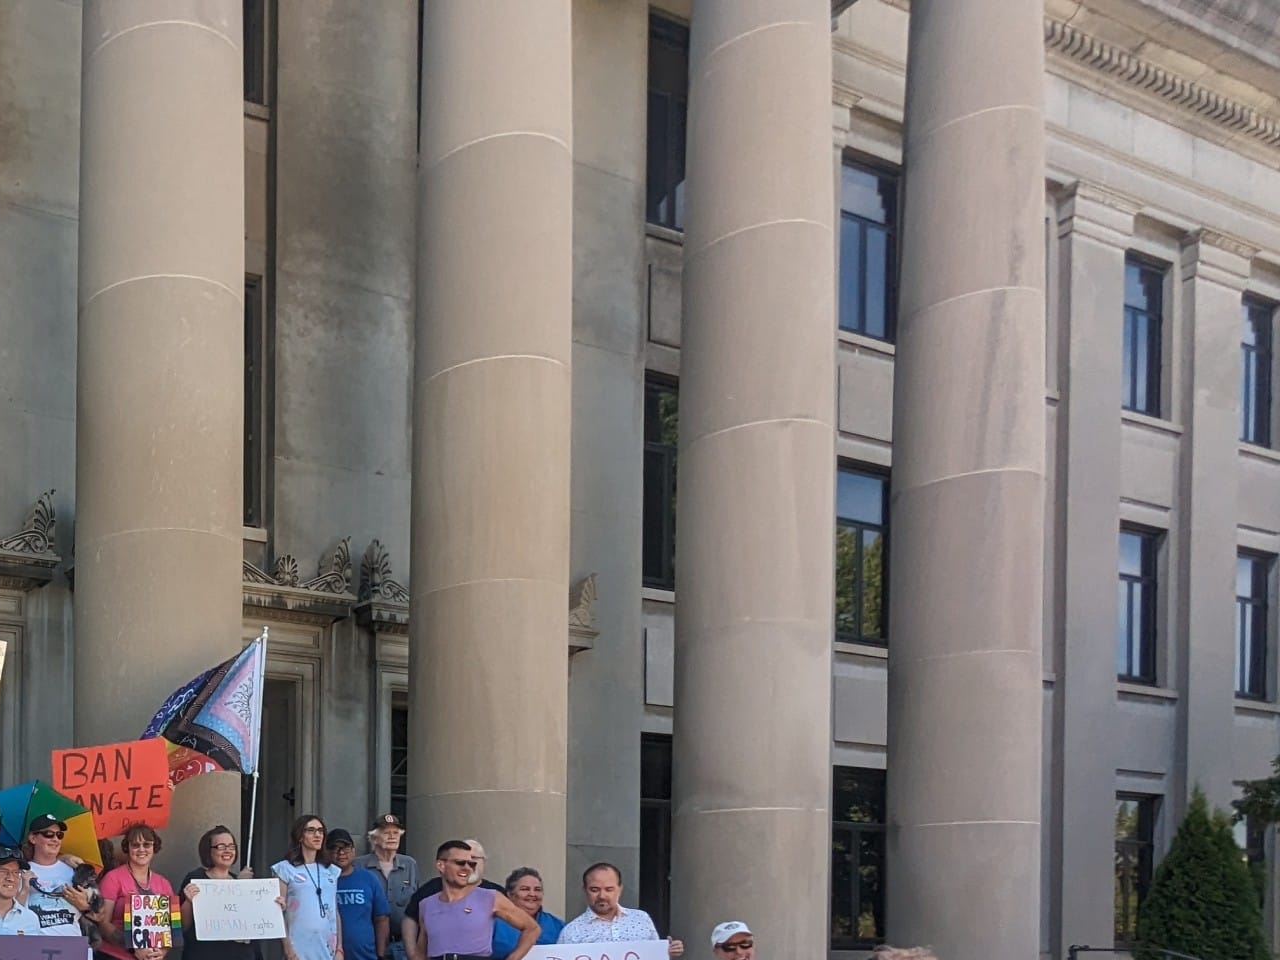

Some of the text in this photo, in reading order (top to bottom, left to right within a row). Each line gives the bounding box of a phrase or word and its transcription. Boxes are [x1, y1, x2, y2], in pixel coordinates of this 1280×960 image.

[62, 747, 132, 790] BAN
[134, 896, 169, 910] DRAG
[336, 892, 365, 904] ANS
[223, 903, 239, 912] ARE
[145, 912, 163, 926] NOT
[133, 929, 172, 948] CRIME
